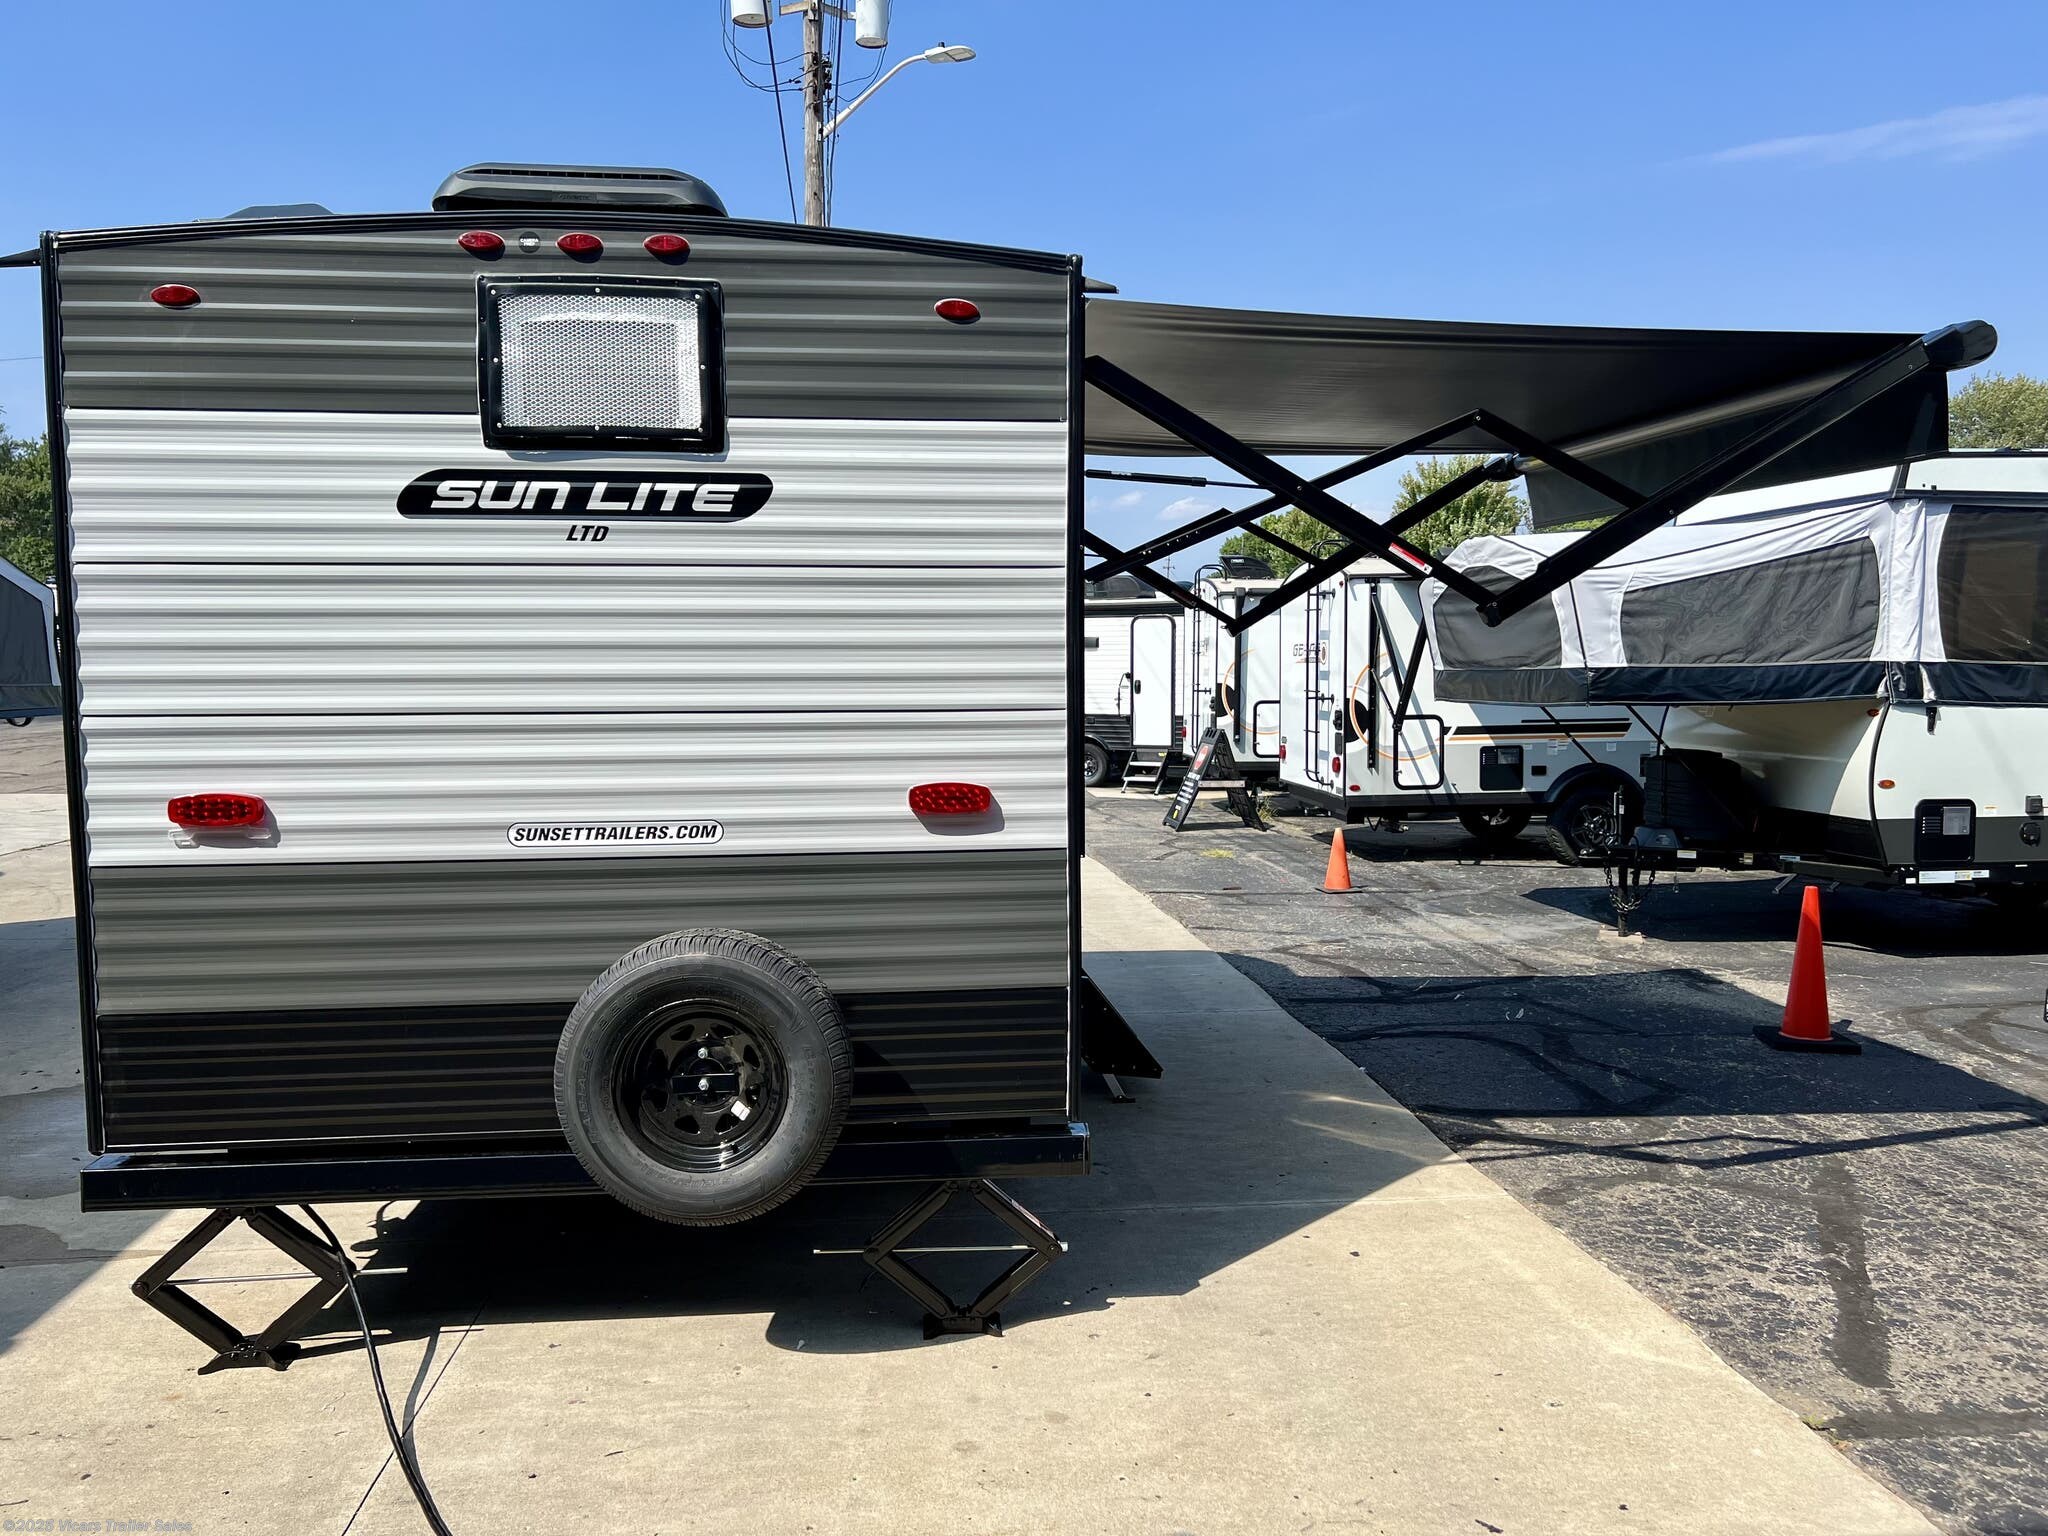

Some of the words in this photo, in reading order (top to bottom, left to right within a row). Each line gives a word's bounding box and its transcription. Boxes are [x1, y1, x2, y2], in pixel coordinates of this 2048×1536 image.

[430, 480, 571, 510] SUN
[586, 481, 741, 513] LITE
[565, 524, 610, 542] LTD
[513, 825, 718, 842] SUNSETTRAILERS.COM
